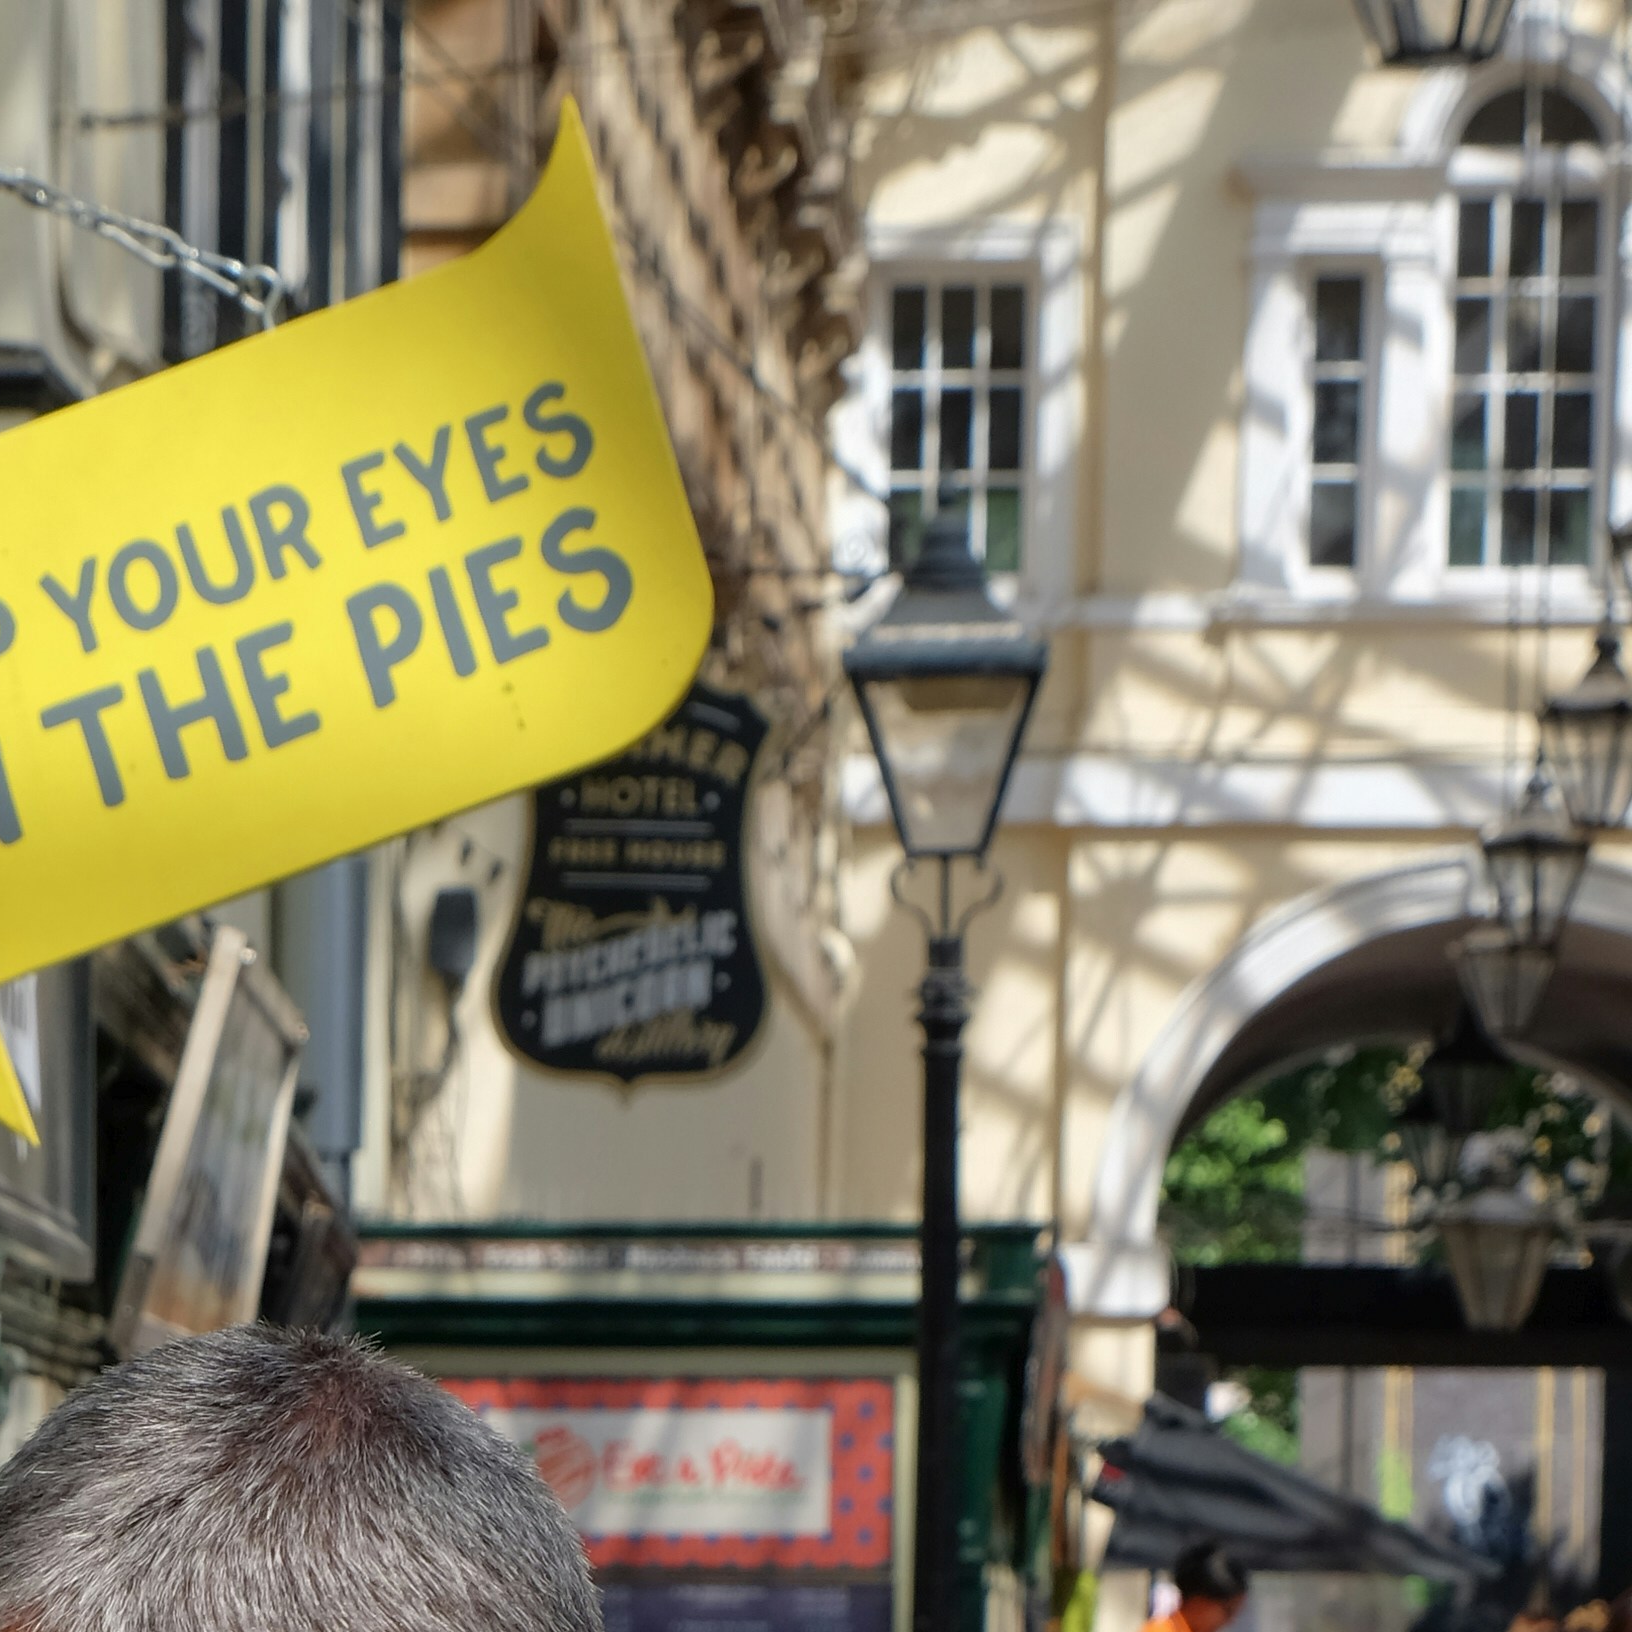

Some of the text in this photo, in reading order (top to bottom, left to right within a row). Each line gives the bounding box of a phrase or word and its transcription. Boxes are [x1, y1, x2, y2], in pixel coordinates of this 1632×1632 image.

[39, 484, 323, 654] YOUR
[340, 382, 593, 549] EYES
[39, 621, 321, 807] THE
[345, 507, 633, 709] PIES
[580, 775, 699, 815] HOTEL
